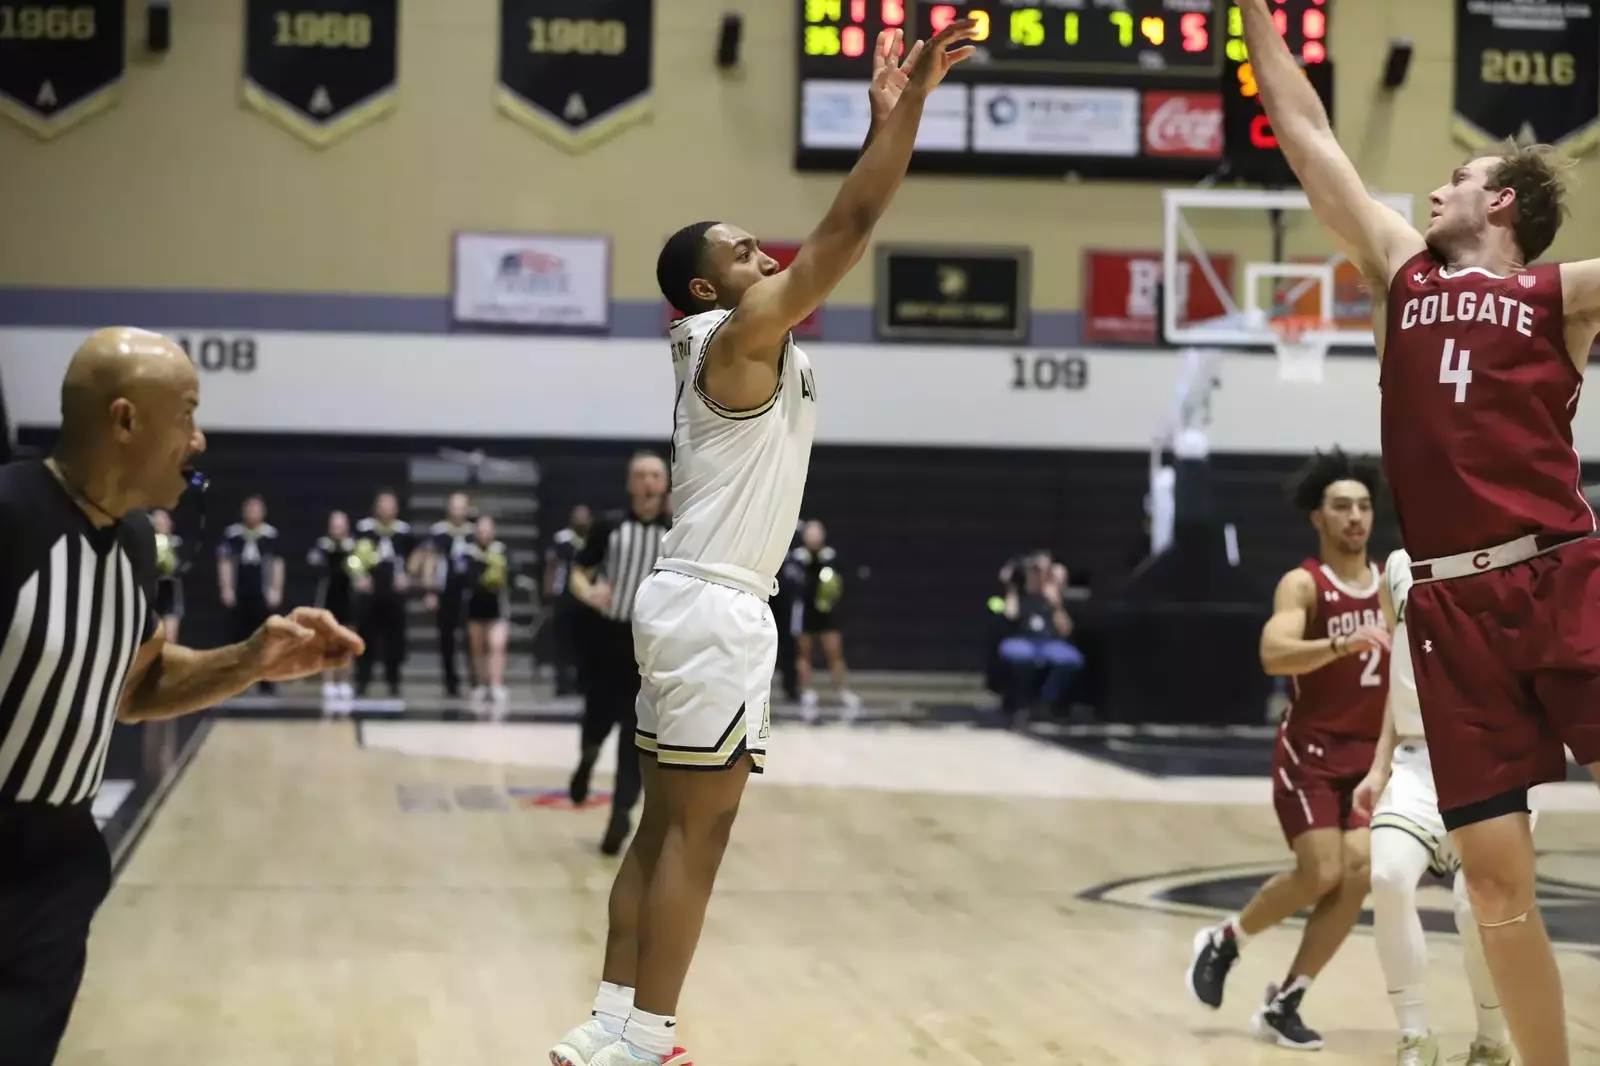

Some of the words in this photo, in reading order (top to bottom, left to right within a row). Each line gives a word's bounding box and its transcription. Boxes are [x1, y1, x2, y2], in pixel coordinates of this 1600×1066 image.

[0, 7, 95, 39] 1966
[1481, 49, 1575, 85] 2016
[1401, 291, 1535, 337] COLGATE
[1011, 356, 1088, 390] 109
[1439, 339, 1473, 403] 4
[1472, 552, 1491, 569] C
[1359, 648, 1382, 687] 2
